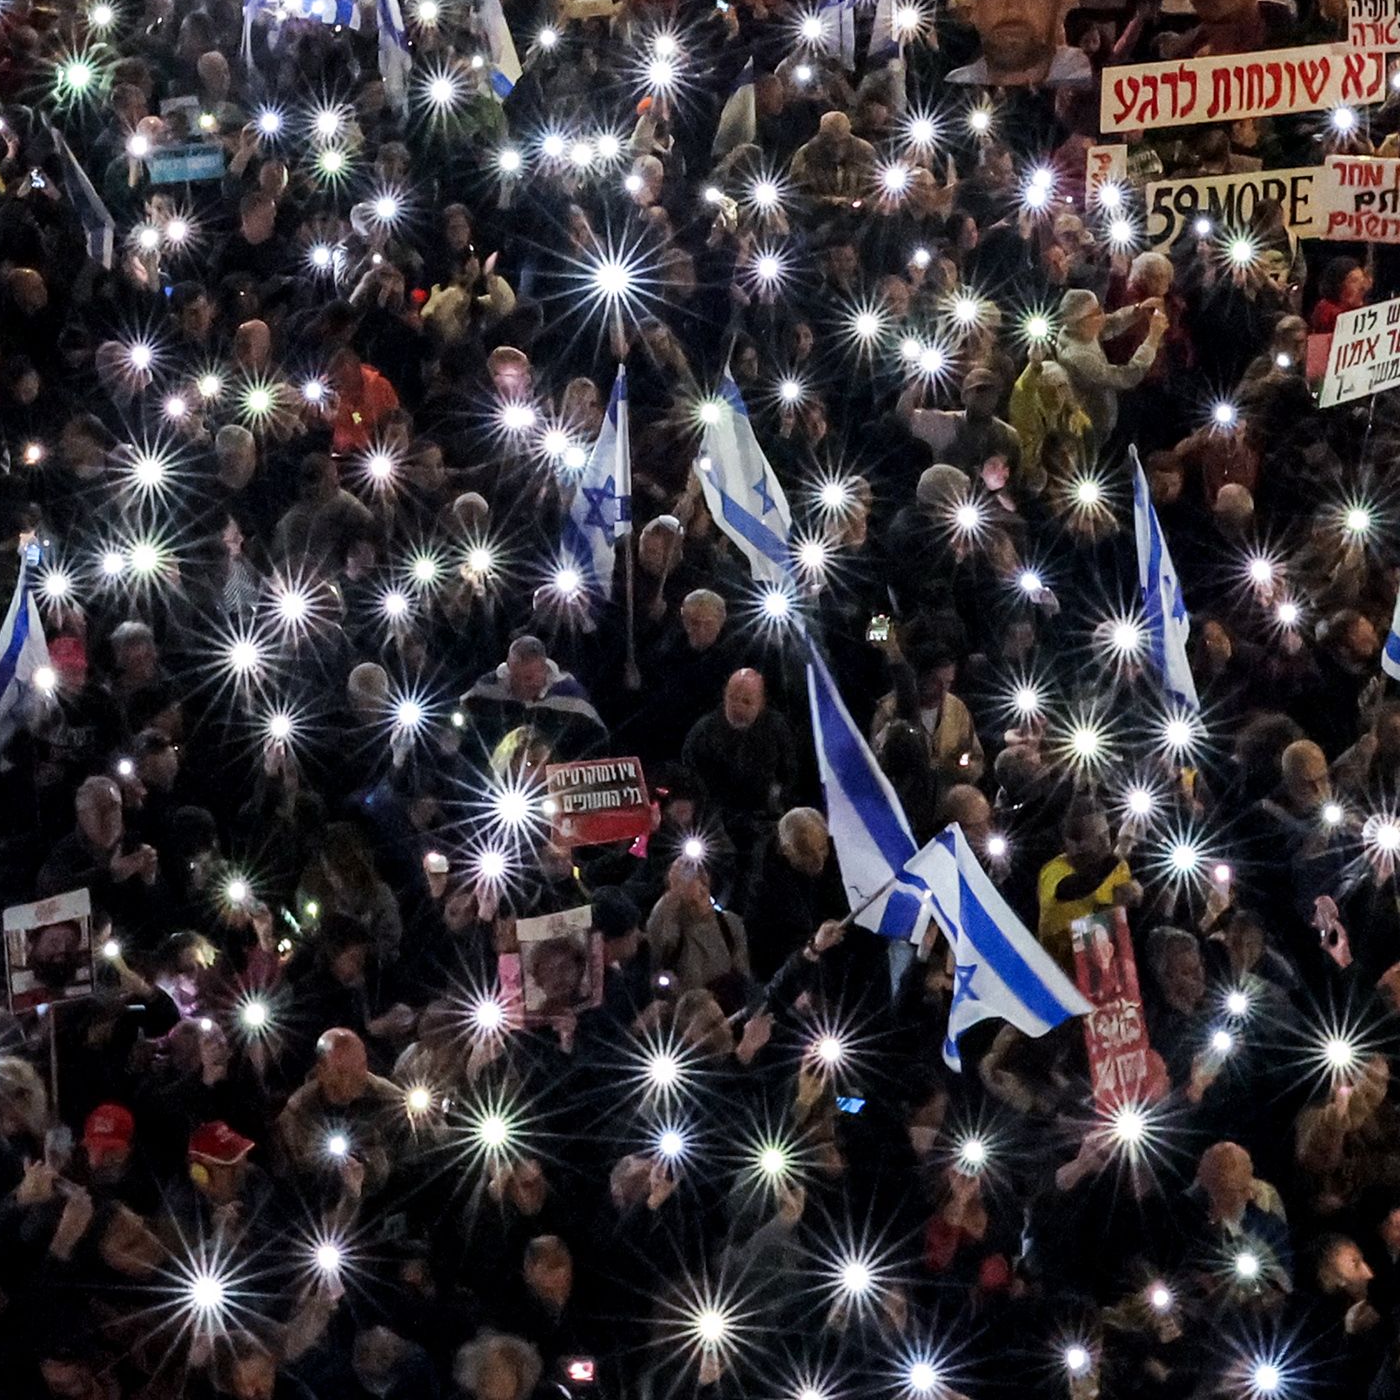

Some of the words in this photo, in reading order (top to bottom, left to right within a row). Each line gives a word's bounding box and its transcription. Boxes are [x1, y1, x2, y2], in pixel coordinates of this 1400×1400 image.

[1113, 62, 1198, 125] לרגע
[1206, 56, 1331, 119] שוכחות
[1332, 161, 1384, 187] מחר
[1353, 308, 1378, 335] לנו
[1335, 333, 1381, 376] אמון
[557, 764, 617, 786] דמוקרטיה
[618, 763, 637, 781] אין
[563, 790, 620, 813] החטופים
[623, 786, 643, 805] בלי
